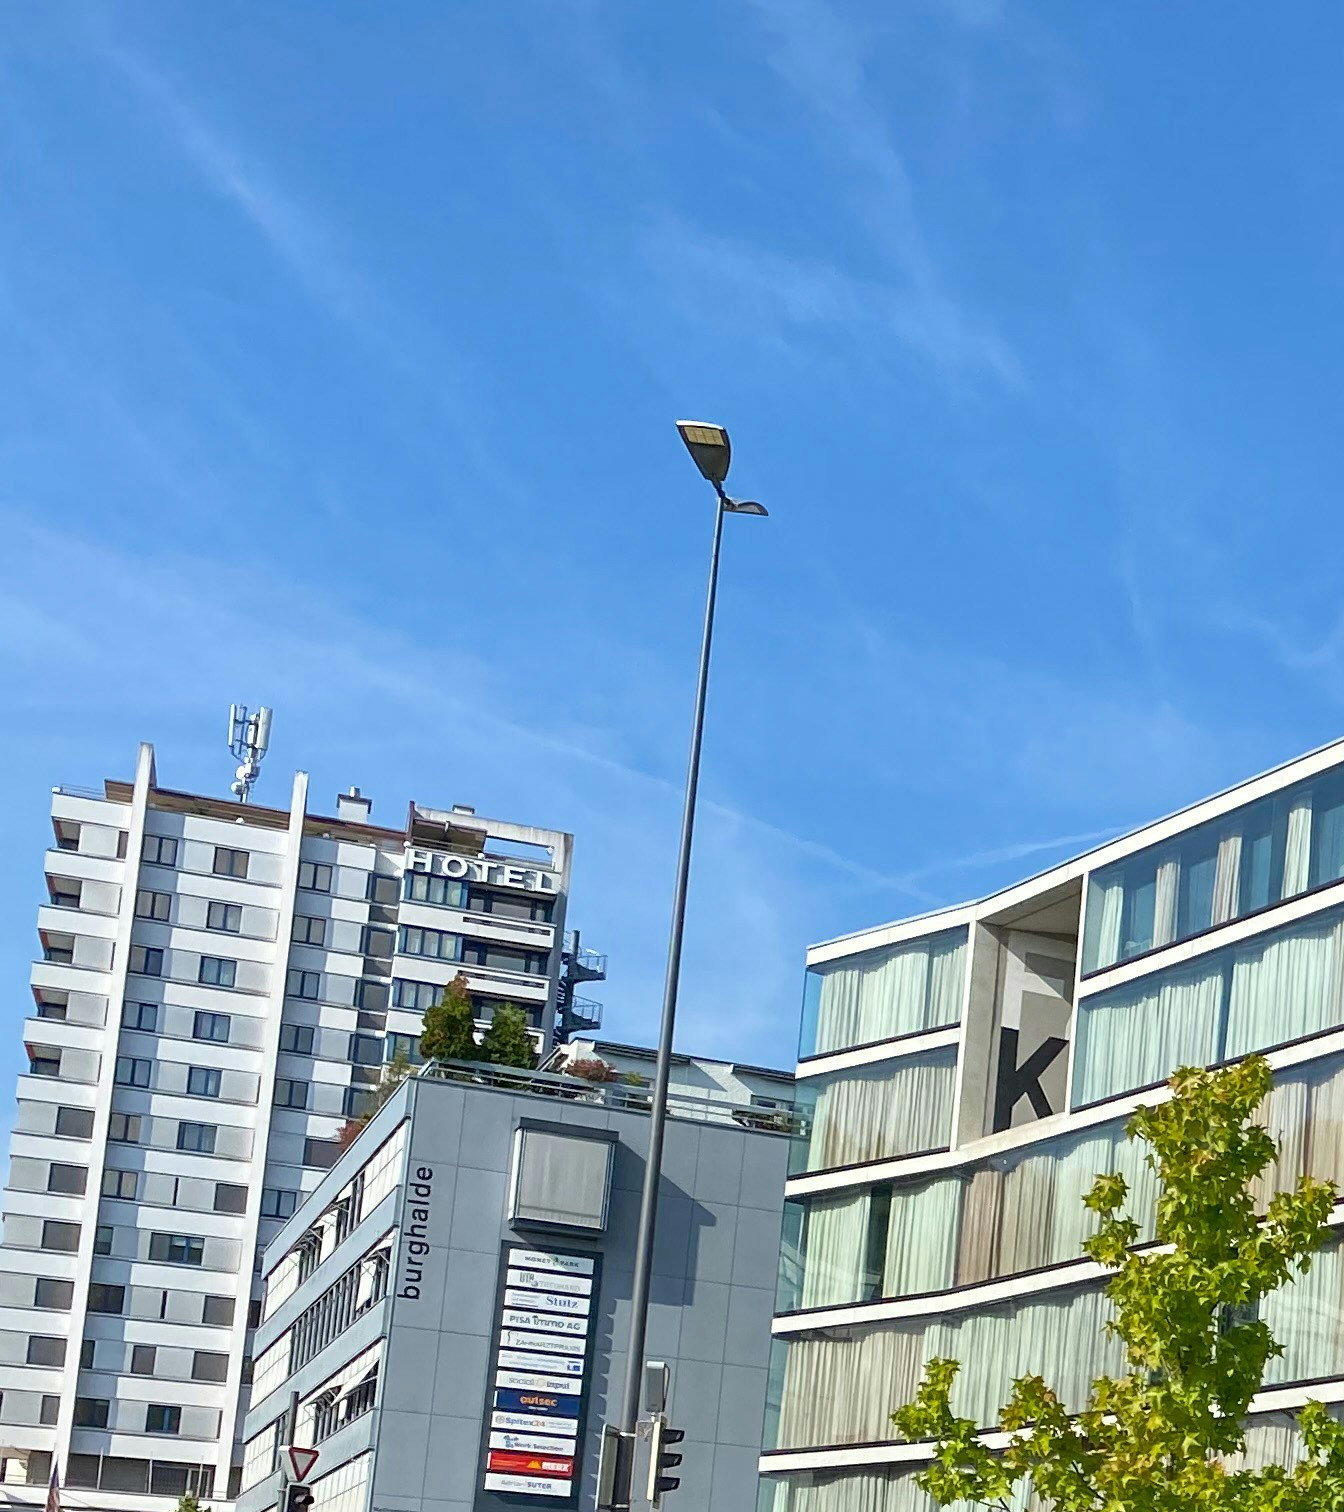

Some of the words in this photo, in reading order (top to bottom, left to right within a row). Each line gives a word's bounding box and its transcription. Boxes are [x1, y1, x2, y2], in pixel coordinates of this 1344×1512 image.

[407, 850, 557, 894] HOTEL
[992, 1026, 1069, 1133] K
[397, 1166, 433, 1300] burghalde
[566, 1322, 581, 1331] AG
